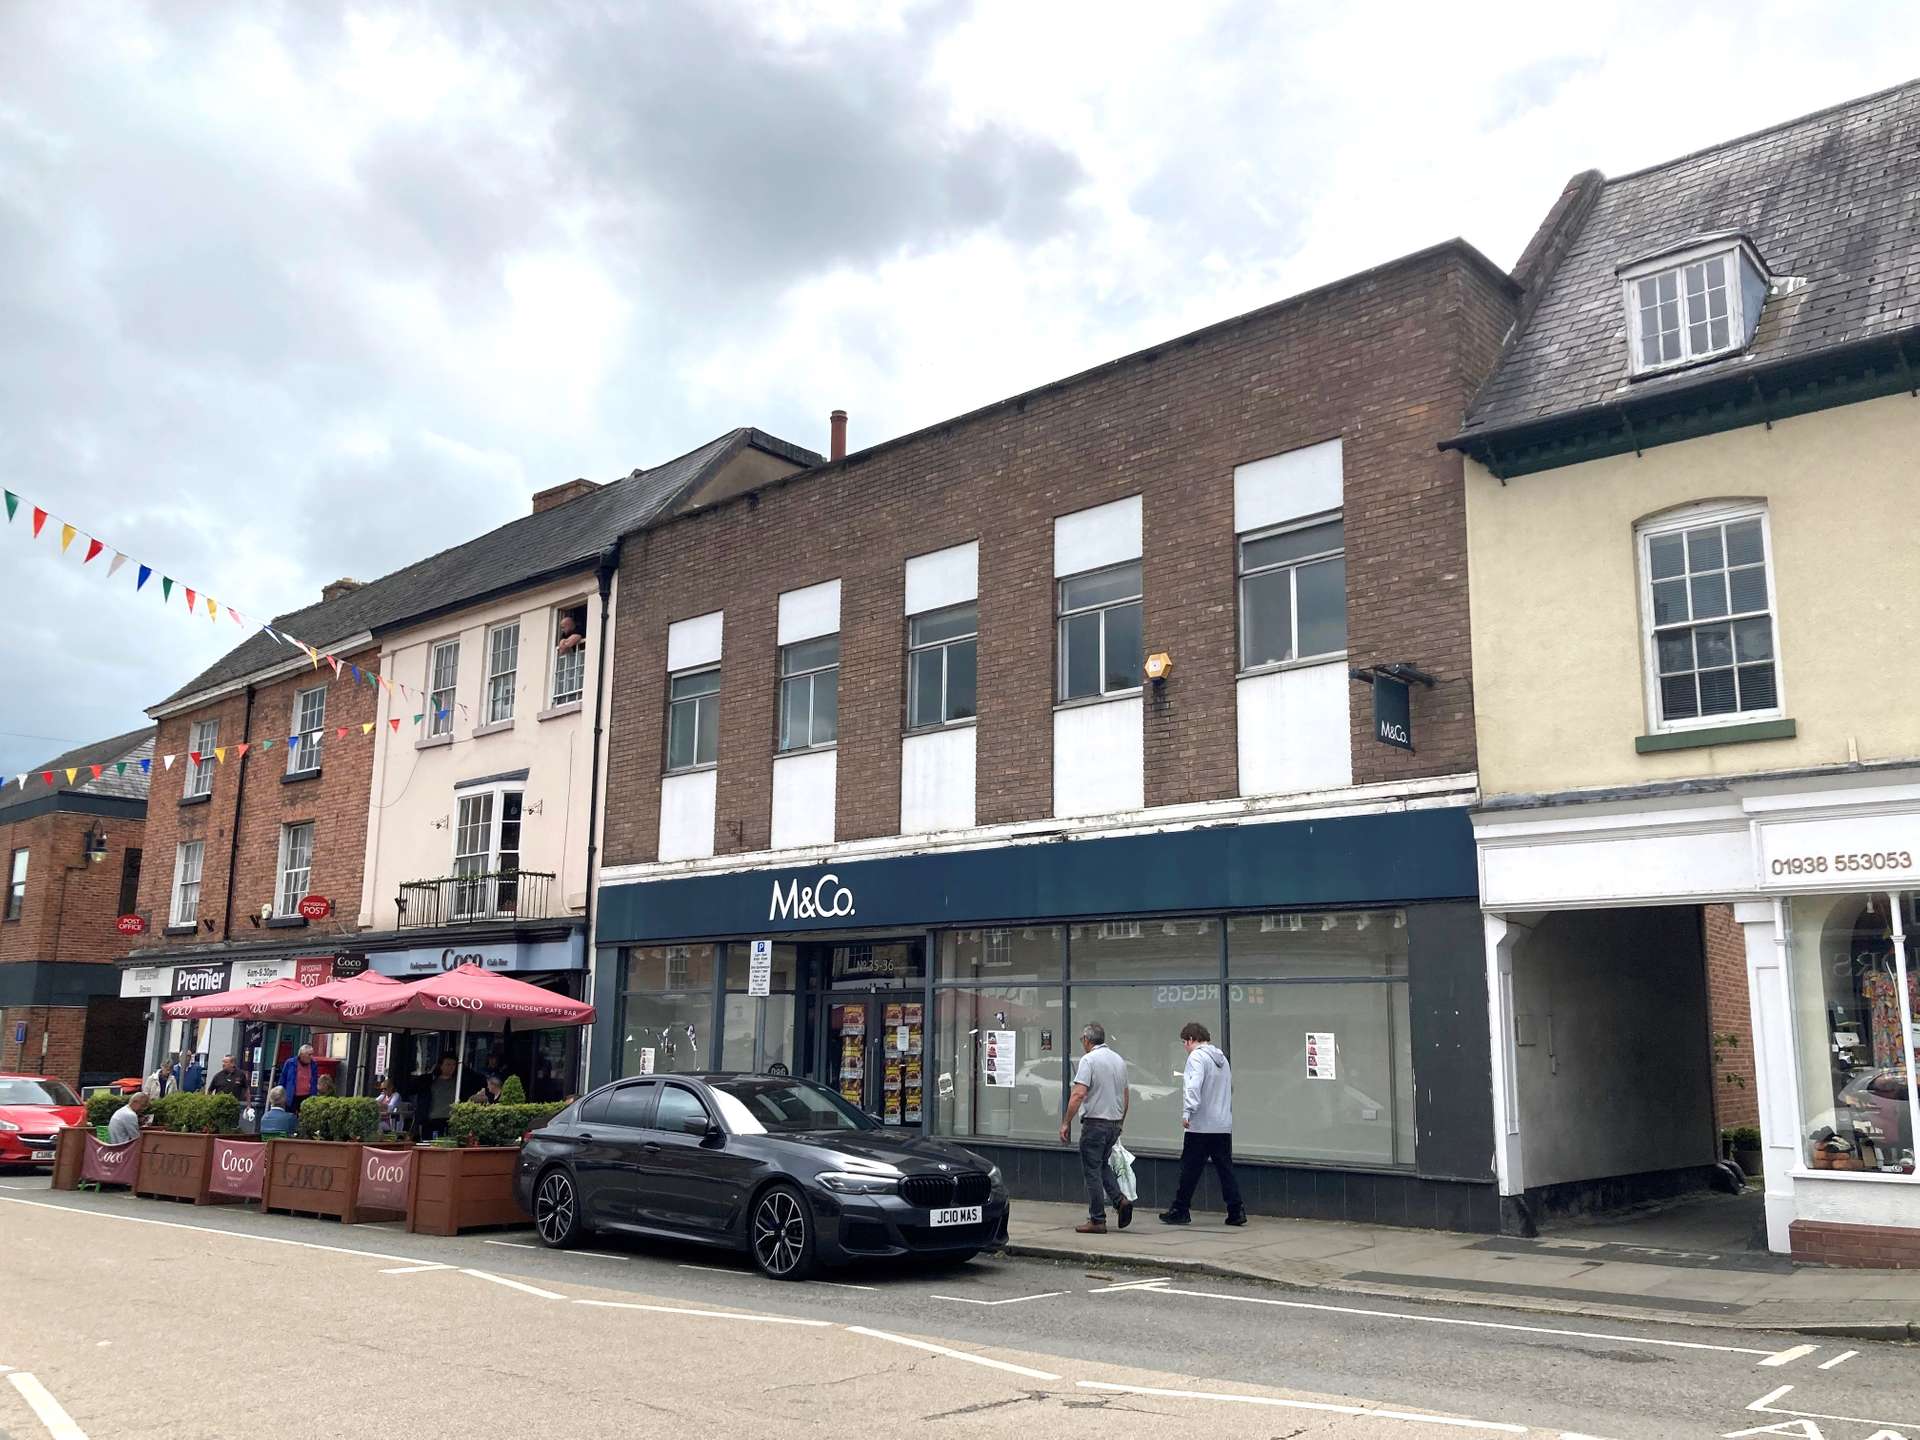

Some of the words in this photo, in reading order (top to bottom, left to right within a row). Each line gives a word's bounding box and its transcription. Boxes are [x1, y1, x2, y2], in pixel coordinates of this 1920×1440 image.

[1381, 720, 1408, 743] M&Co.
[1772, 856, 1828, 875] 01938
[1835, 851, 1912, 871] 553053
[769, 874, 855, 920] M&Co.
[303, 906, 325, 914] POST
[118, 923, 142, 931] OFFICE
[337, 956, 361, 967] Coco
[177, 967, 225, 991] Premier
[301, 974, 320, 987] POST
[436, 995, 483, 1010] COCO
[494, 1002, 543, 1013] INDEPENDENT
[563, 1009, 577, 1017] BAR
[221, 1149, 253, 1173] Coco
[367, 1156, 404, 1183] Coco
[937, 1210, 958, 1224] JC10
[960, 1208, 978, 1222] MAS
